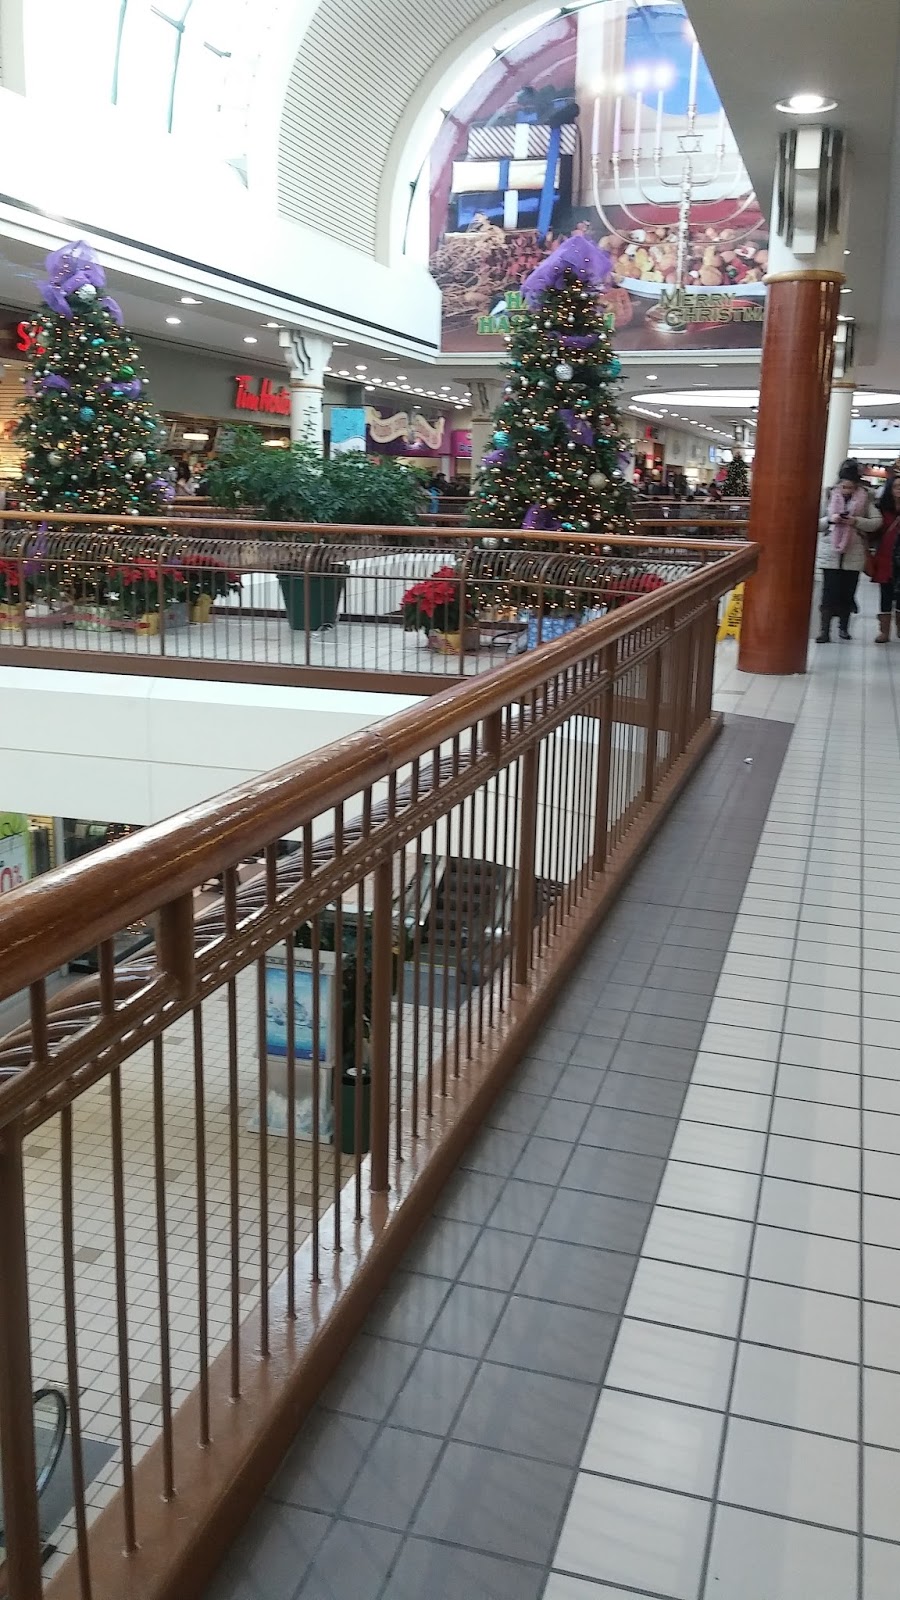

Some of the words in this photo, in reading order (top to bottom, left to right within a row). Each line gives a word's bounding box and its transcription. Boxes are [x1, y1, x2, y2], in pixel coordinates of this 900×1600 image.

[660, 288, 736, 308] MERRY
[665, 307, 764, 326] CHRISTM
[235, 375, 259, 411] Tim
